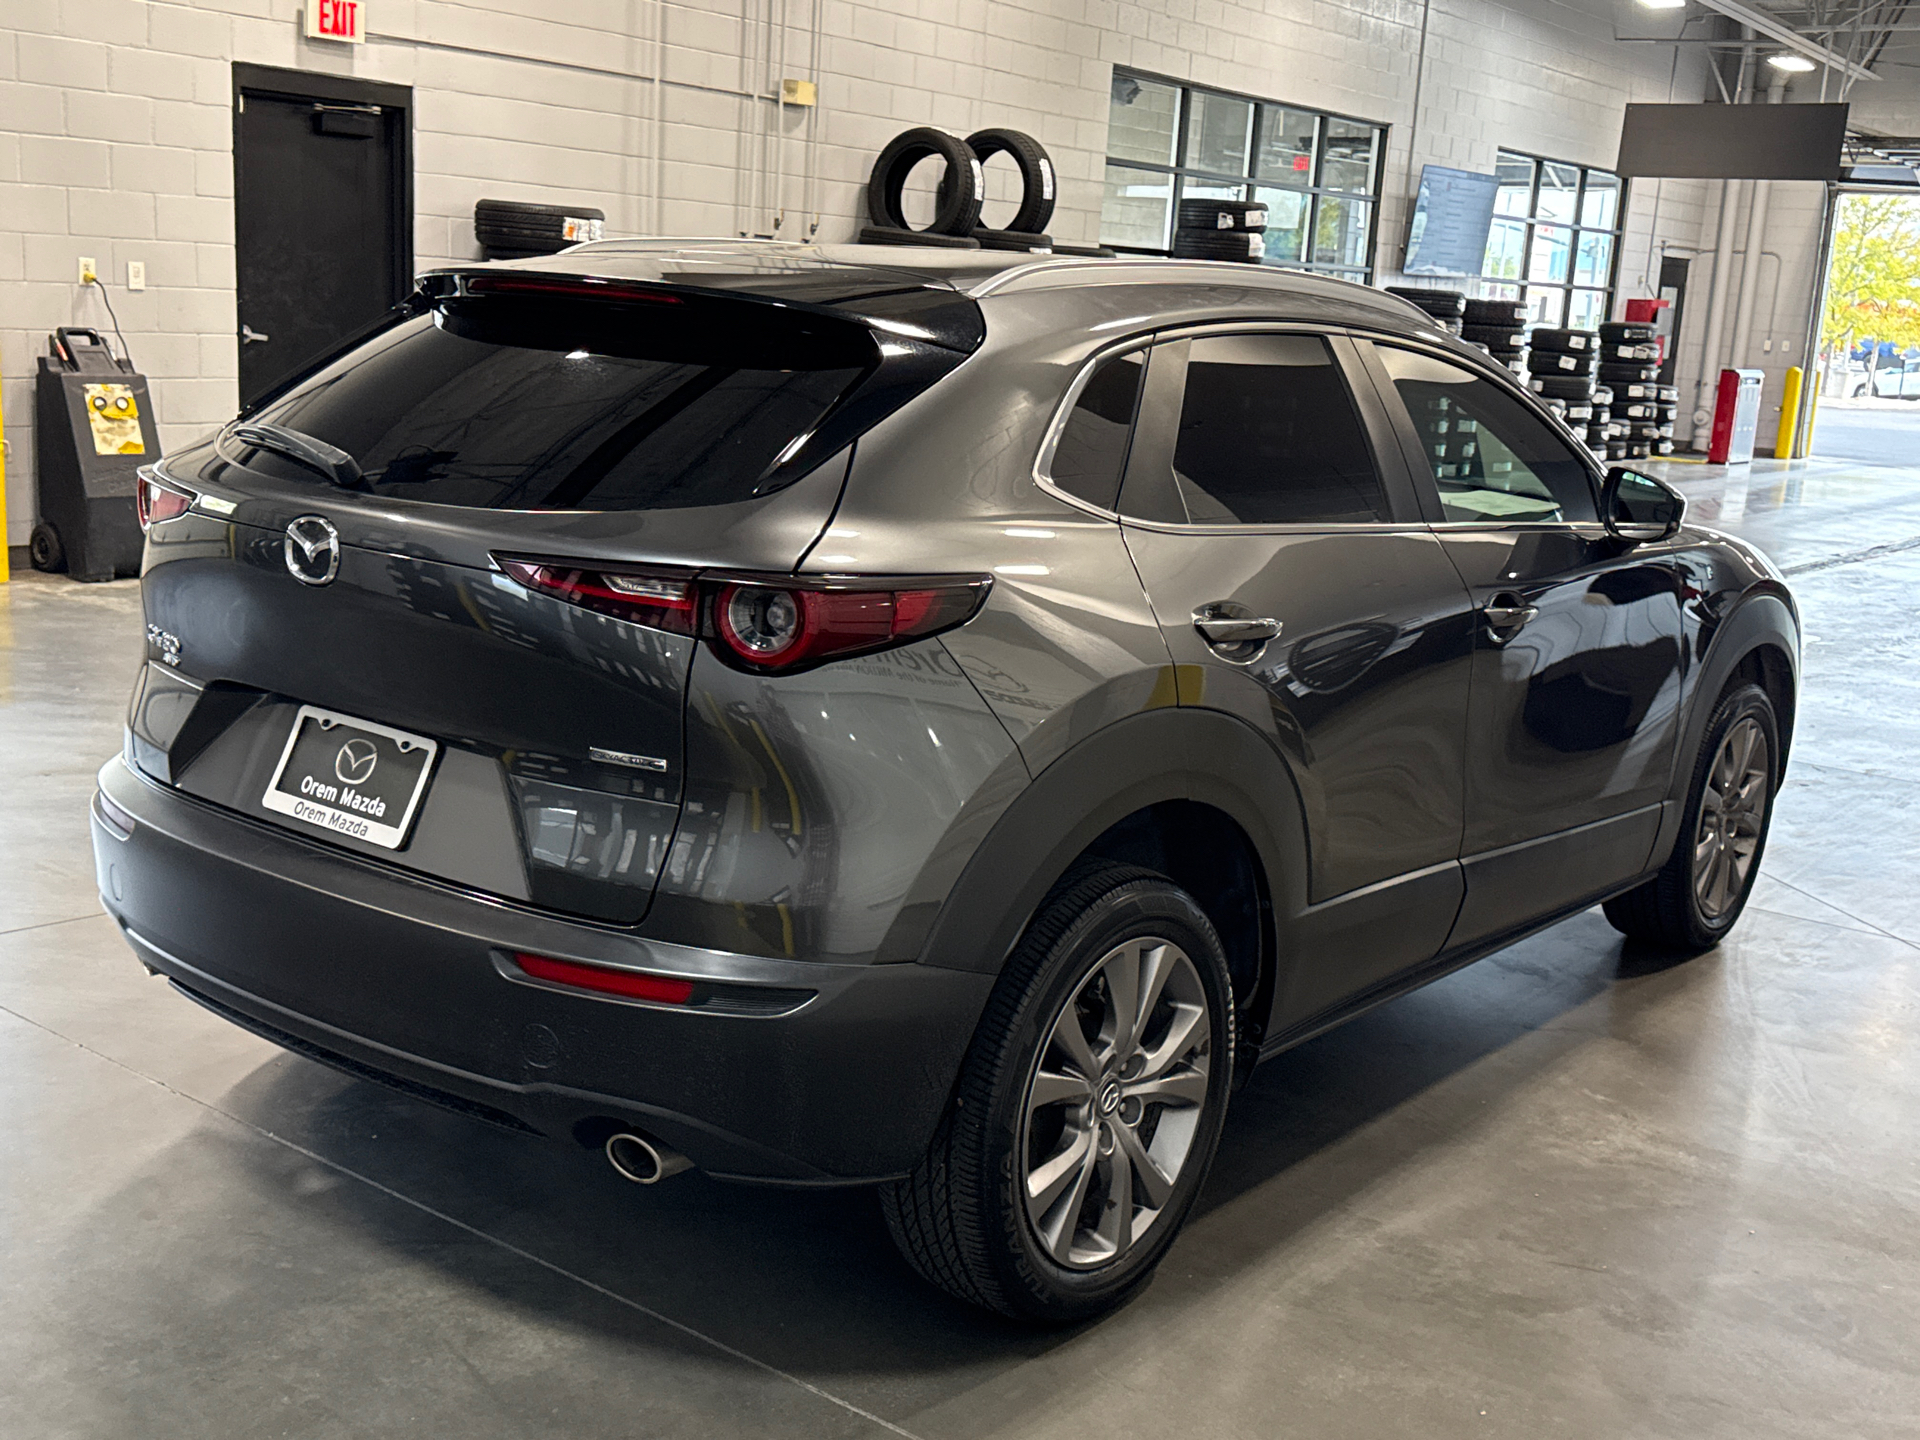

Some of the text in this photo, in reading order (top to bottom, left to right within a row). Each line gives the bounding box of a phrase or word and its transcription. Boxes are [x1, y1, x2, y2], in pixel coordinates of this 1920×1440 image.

[319, 0, 357, 38] EXIT
[301, 776, 386, 817] Orem Mazda
[294, 802, 369, 836] Orem Mazda
